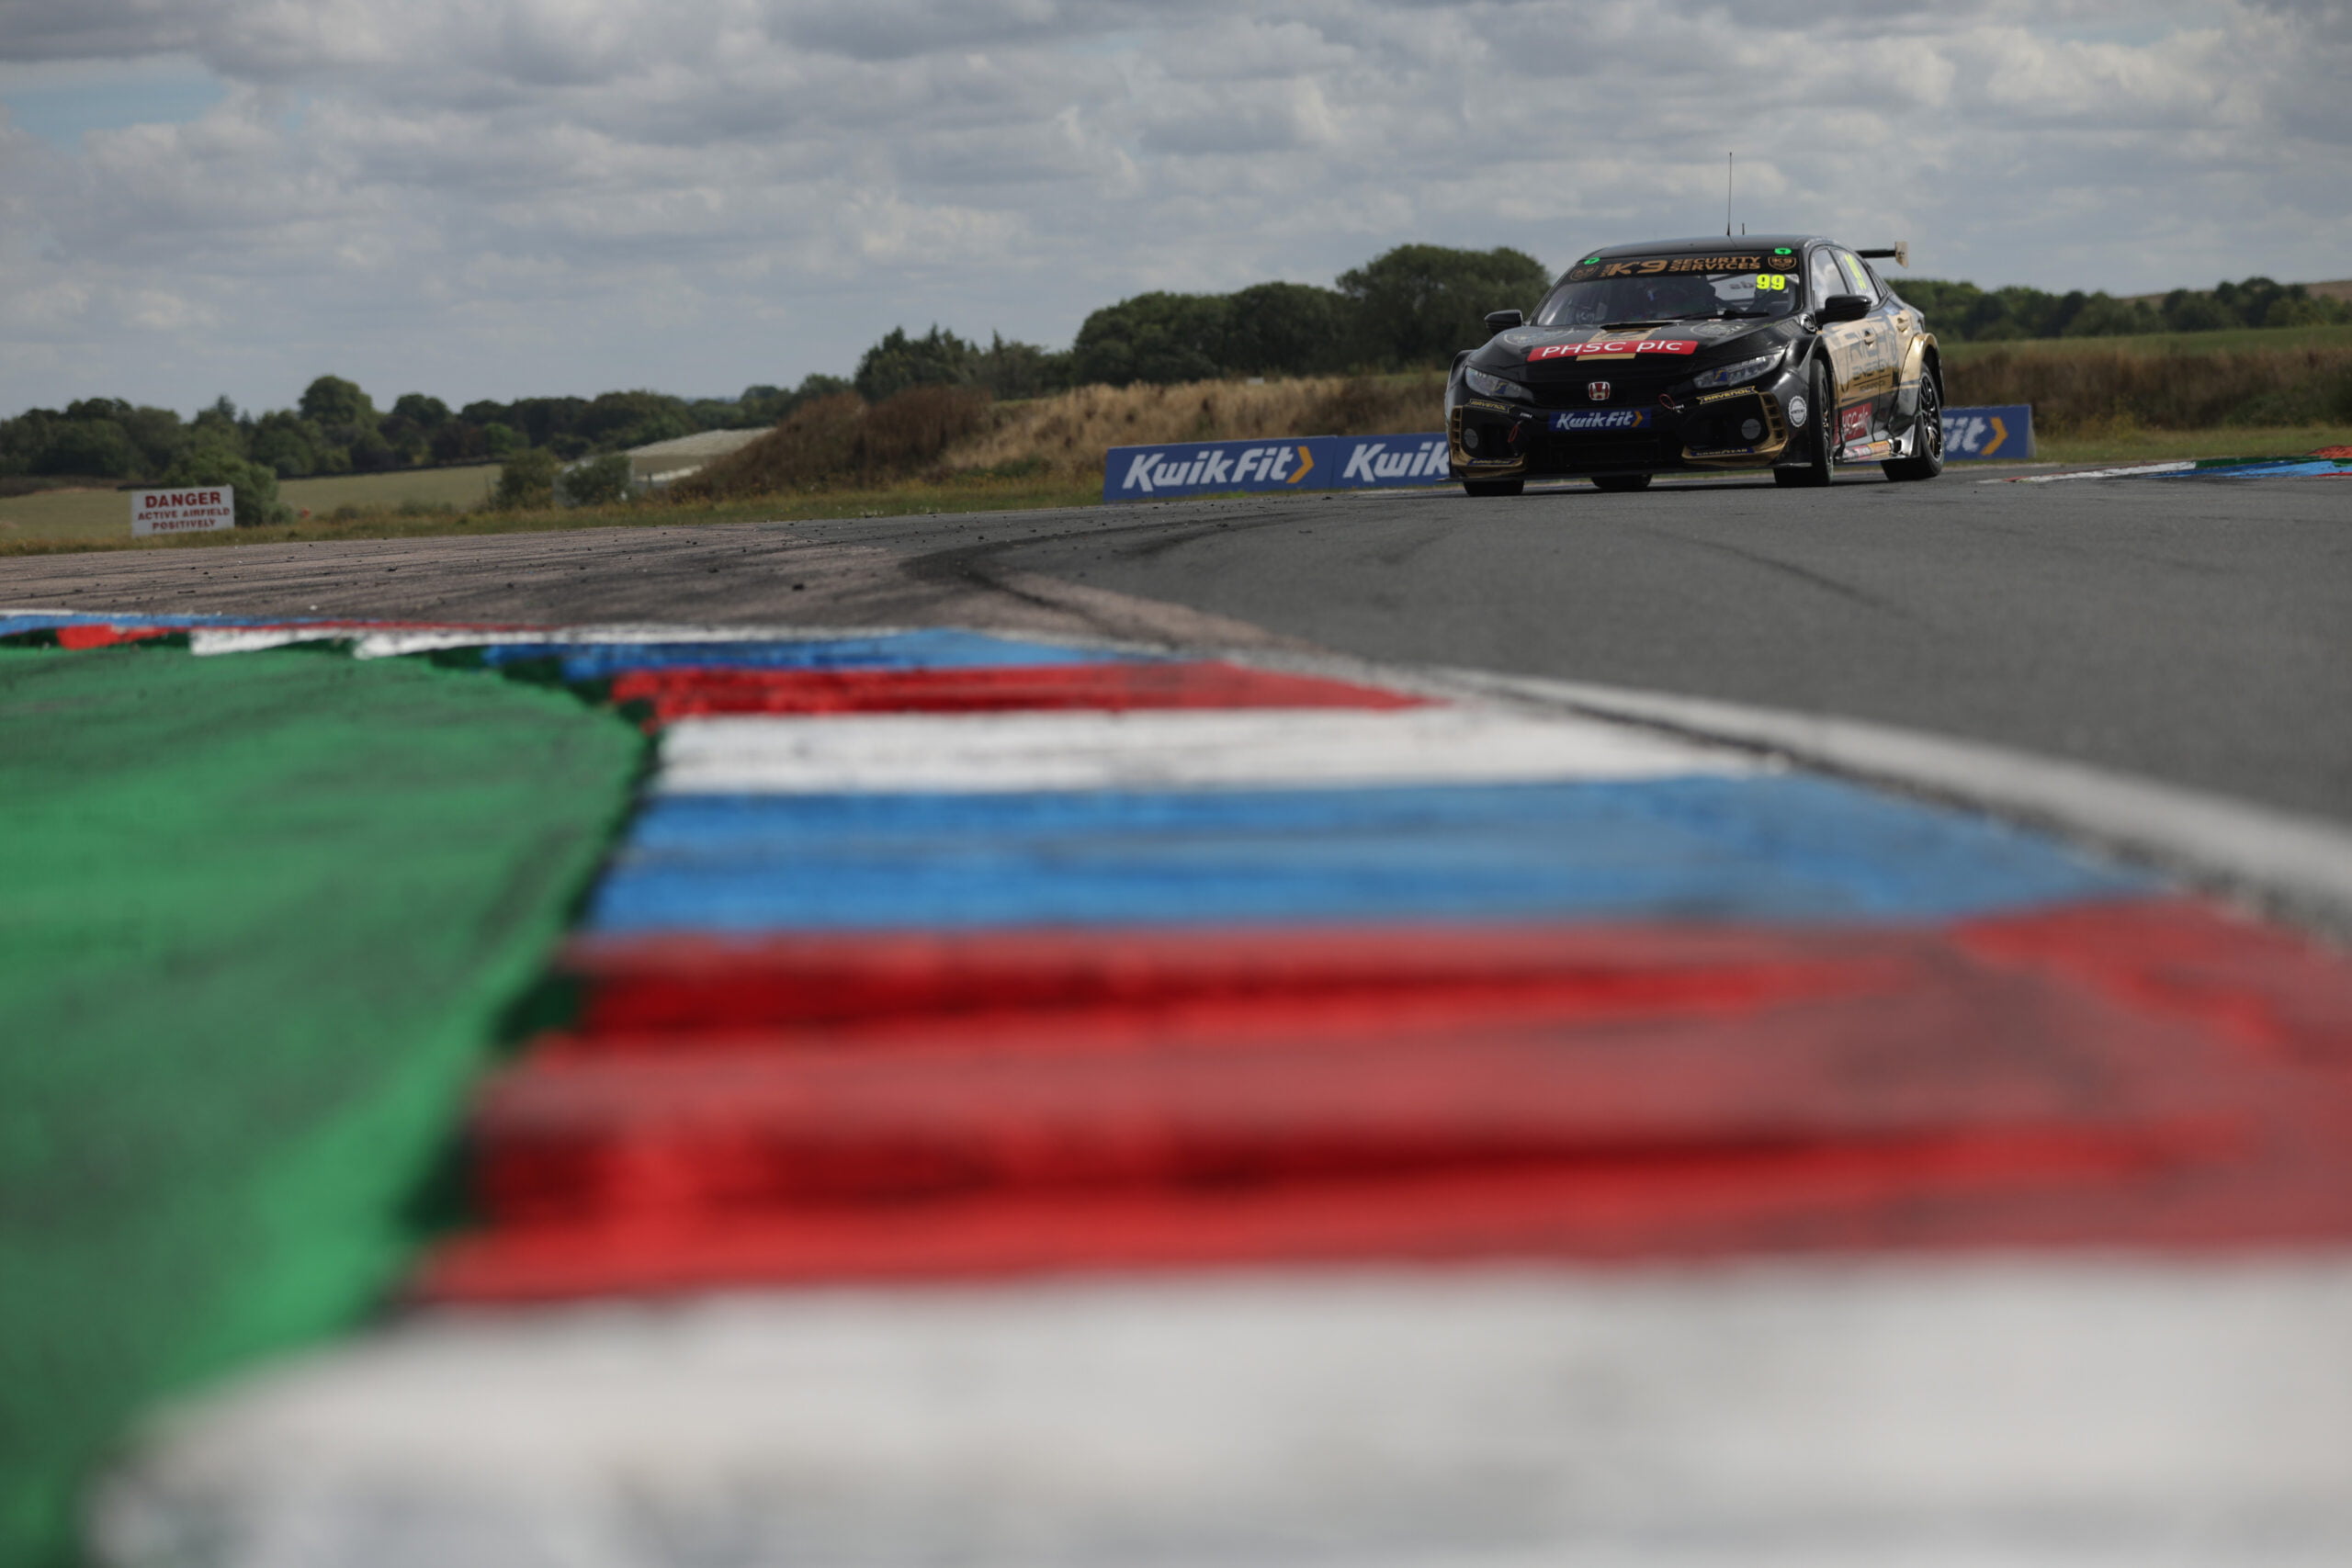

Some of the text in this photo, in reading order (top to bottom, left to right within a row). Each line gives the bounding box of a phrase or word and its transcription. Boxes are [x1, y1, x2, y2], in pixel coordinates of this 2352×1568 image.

[1607, 260, 1668, 276] K9
[1668, 263, 1761, 272] SERVICES
[1672, 256, 1761, 267] SECURITY
[1756, 274, 1786, 290] 99
[1542, 341, 1683, 357] PHSC plc
[145, 491, 221, 508] DANGER
[139, 508, 230, 520] ACTIVE AIRFIELD
[153, 519, 216, 530] POSITIVELY
